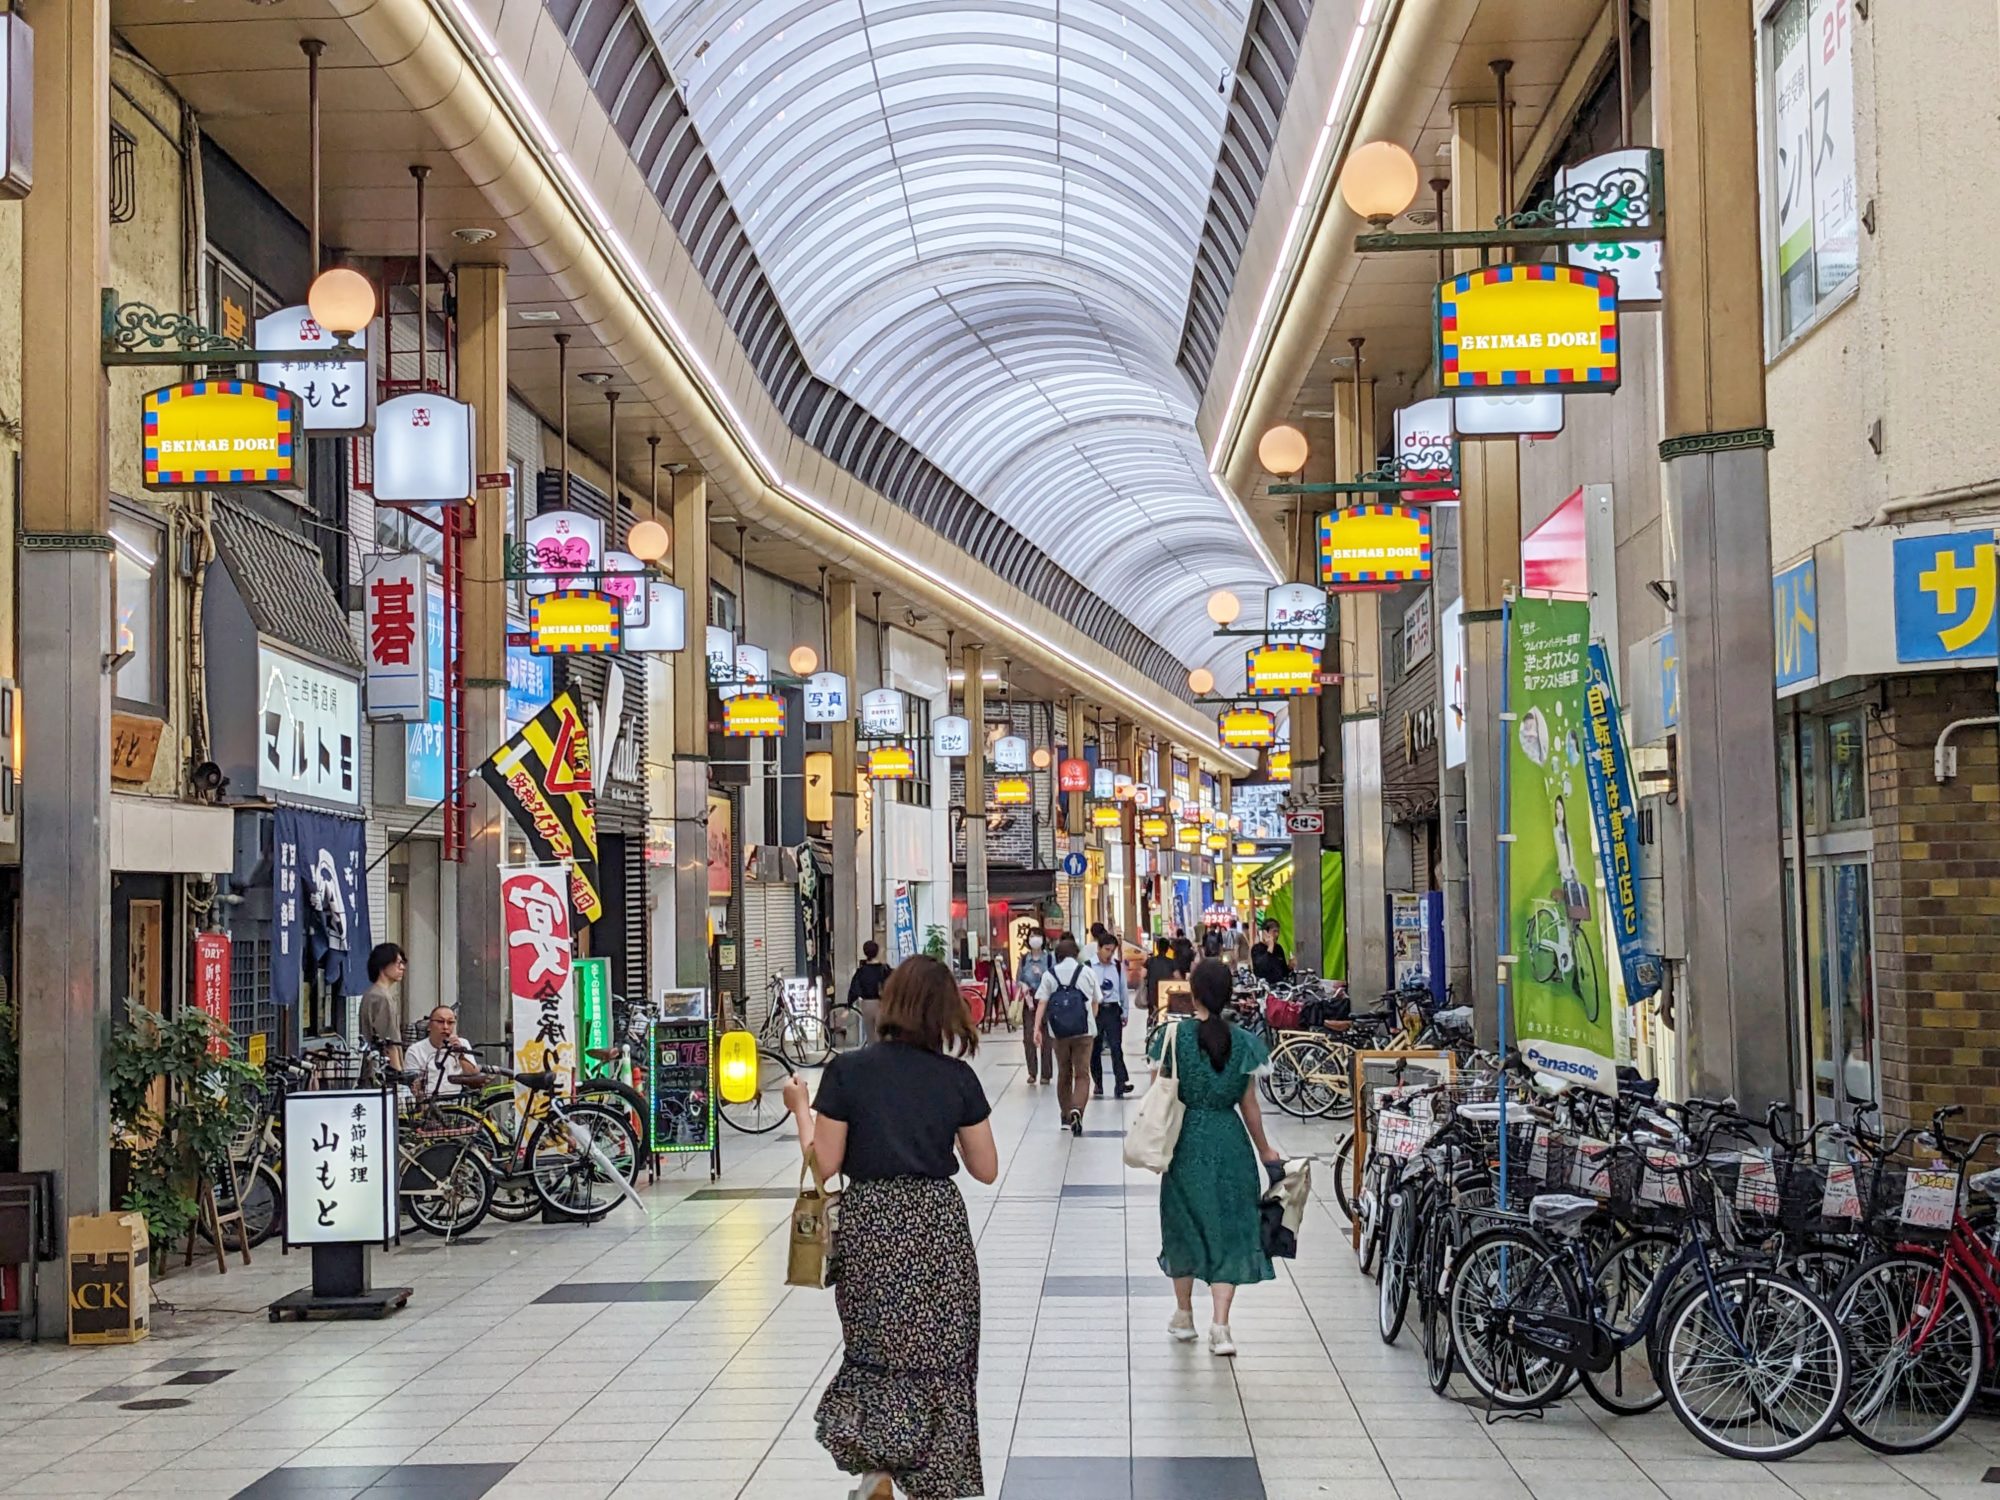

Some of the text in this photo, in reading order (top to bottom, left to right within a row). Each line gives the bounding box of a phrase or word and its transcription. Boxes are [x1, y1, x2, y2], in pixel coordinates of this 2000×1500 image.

[1460, 332, 1598, 350] EKIMAE DORI
[161, 438, 276, 453] EKIMAE DORI
[1333, 546, 1419, 559] EKIMAE DORI
[1919, 543, 1996, 653] サ
[370, 576, 416, 667] 碁
[540, 624, 610, 635] EKIMAE DORI
[1255, 672, 1290, 681] EKIMAE
[808, 691, 842, 708] 写真
[1291, 816, 1318, 829] たばこ
[1527, 1047, 1599, 1081] Panasonic
[350, 1102, 369, 1185] 季節料理
[311, 1121, 340, 1228] 山もと
